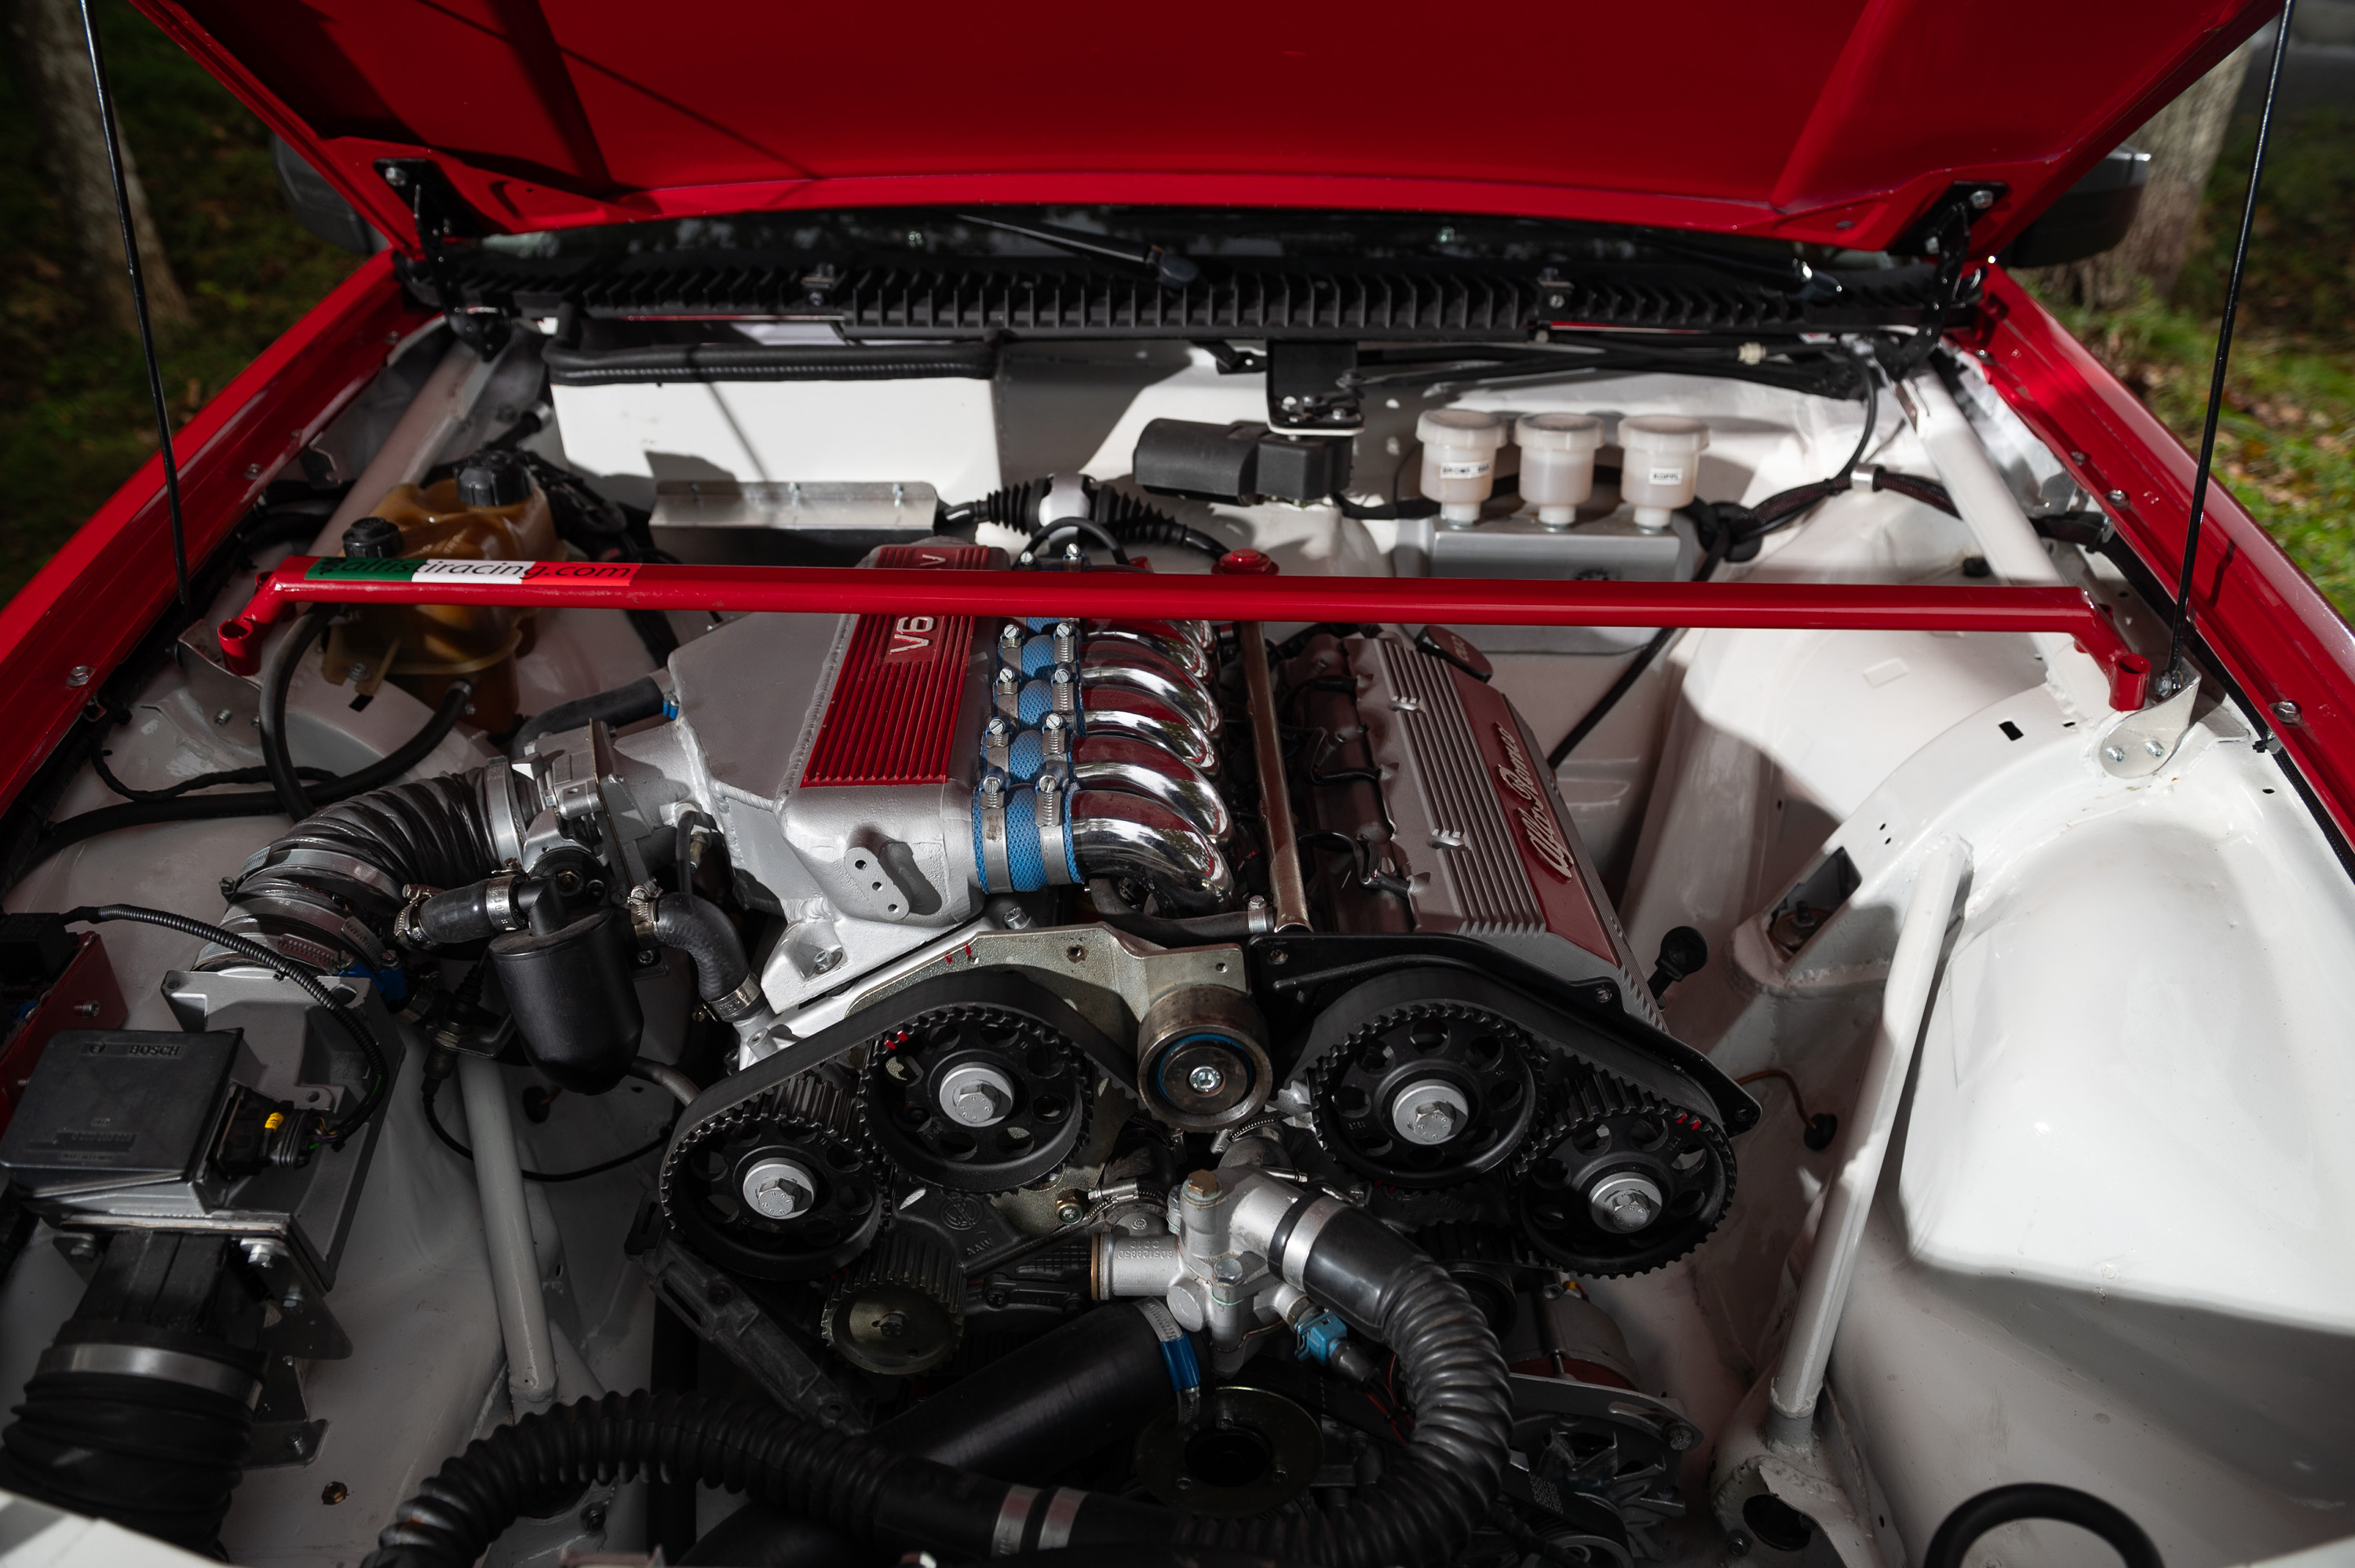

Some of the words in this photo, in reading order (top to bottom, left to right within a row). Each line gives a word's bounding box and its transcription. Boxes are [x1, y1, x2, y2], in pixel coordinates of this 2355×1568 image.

[340, 557, 632, 579] alfistiracing.com
[889, 615, 935, 656] V6
[1492, 720, 1539, 802] Romeo
[1517, 798, 1575, 881] Alfa
[128, 1045, 181, 1056] BOSCH
